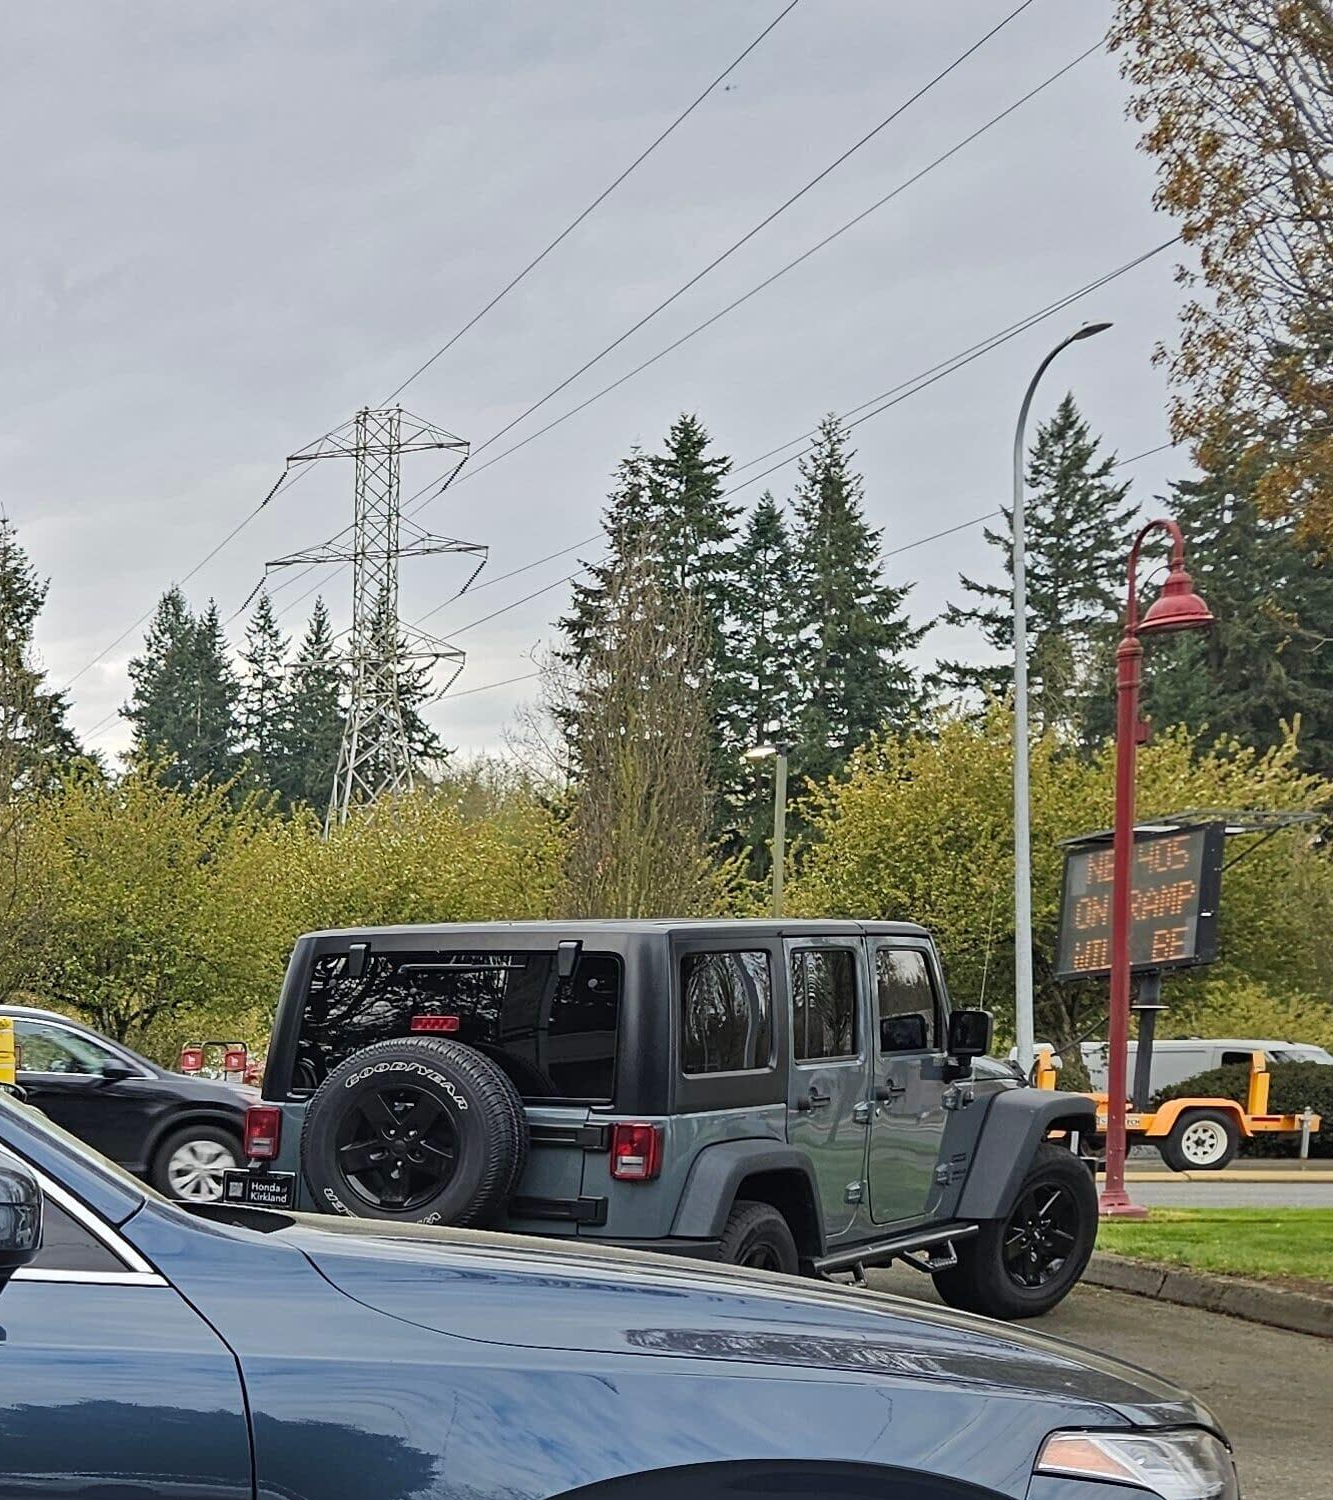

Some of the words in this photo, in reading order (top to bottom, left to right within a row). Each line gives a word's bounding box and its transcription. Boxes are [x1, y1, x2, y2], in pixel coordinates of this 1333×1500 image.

[1138, 834, 1191, 875] 405
[1074, 894, 1110, 930] ON
[1130, 880, 1197, 920] RAMP
[1151, 926, 1190, 963] BE
[345, 1061, 469, 1110] GOODYEAR
[250, 1191, 288, 1203] Kirkland
[251, 1182, 281, 1193] Honda
